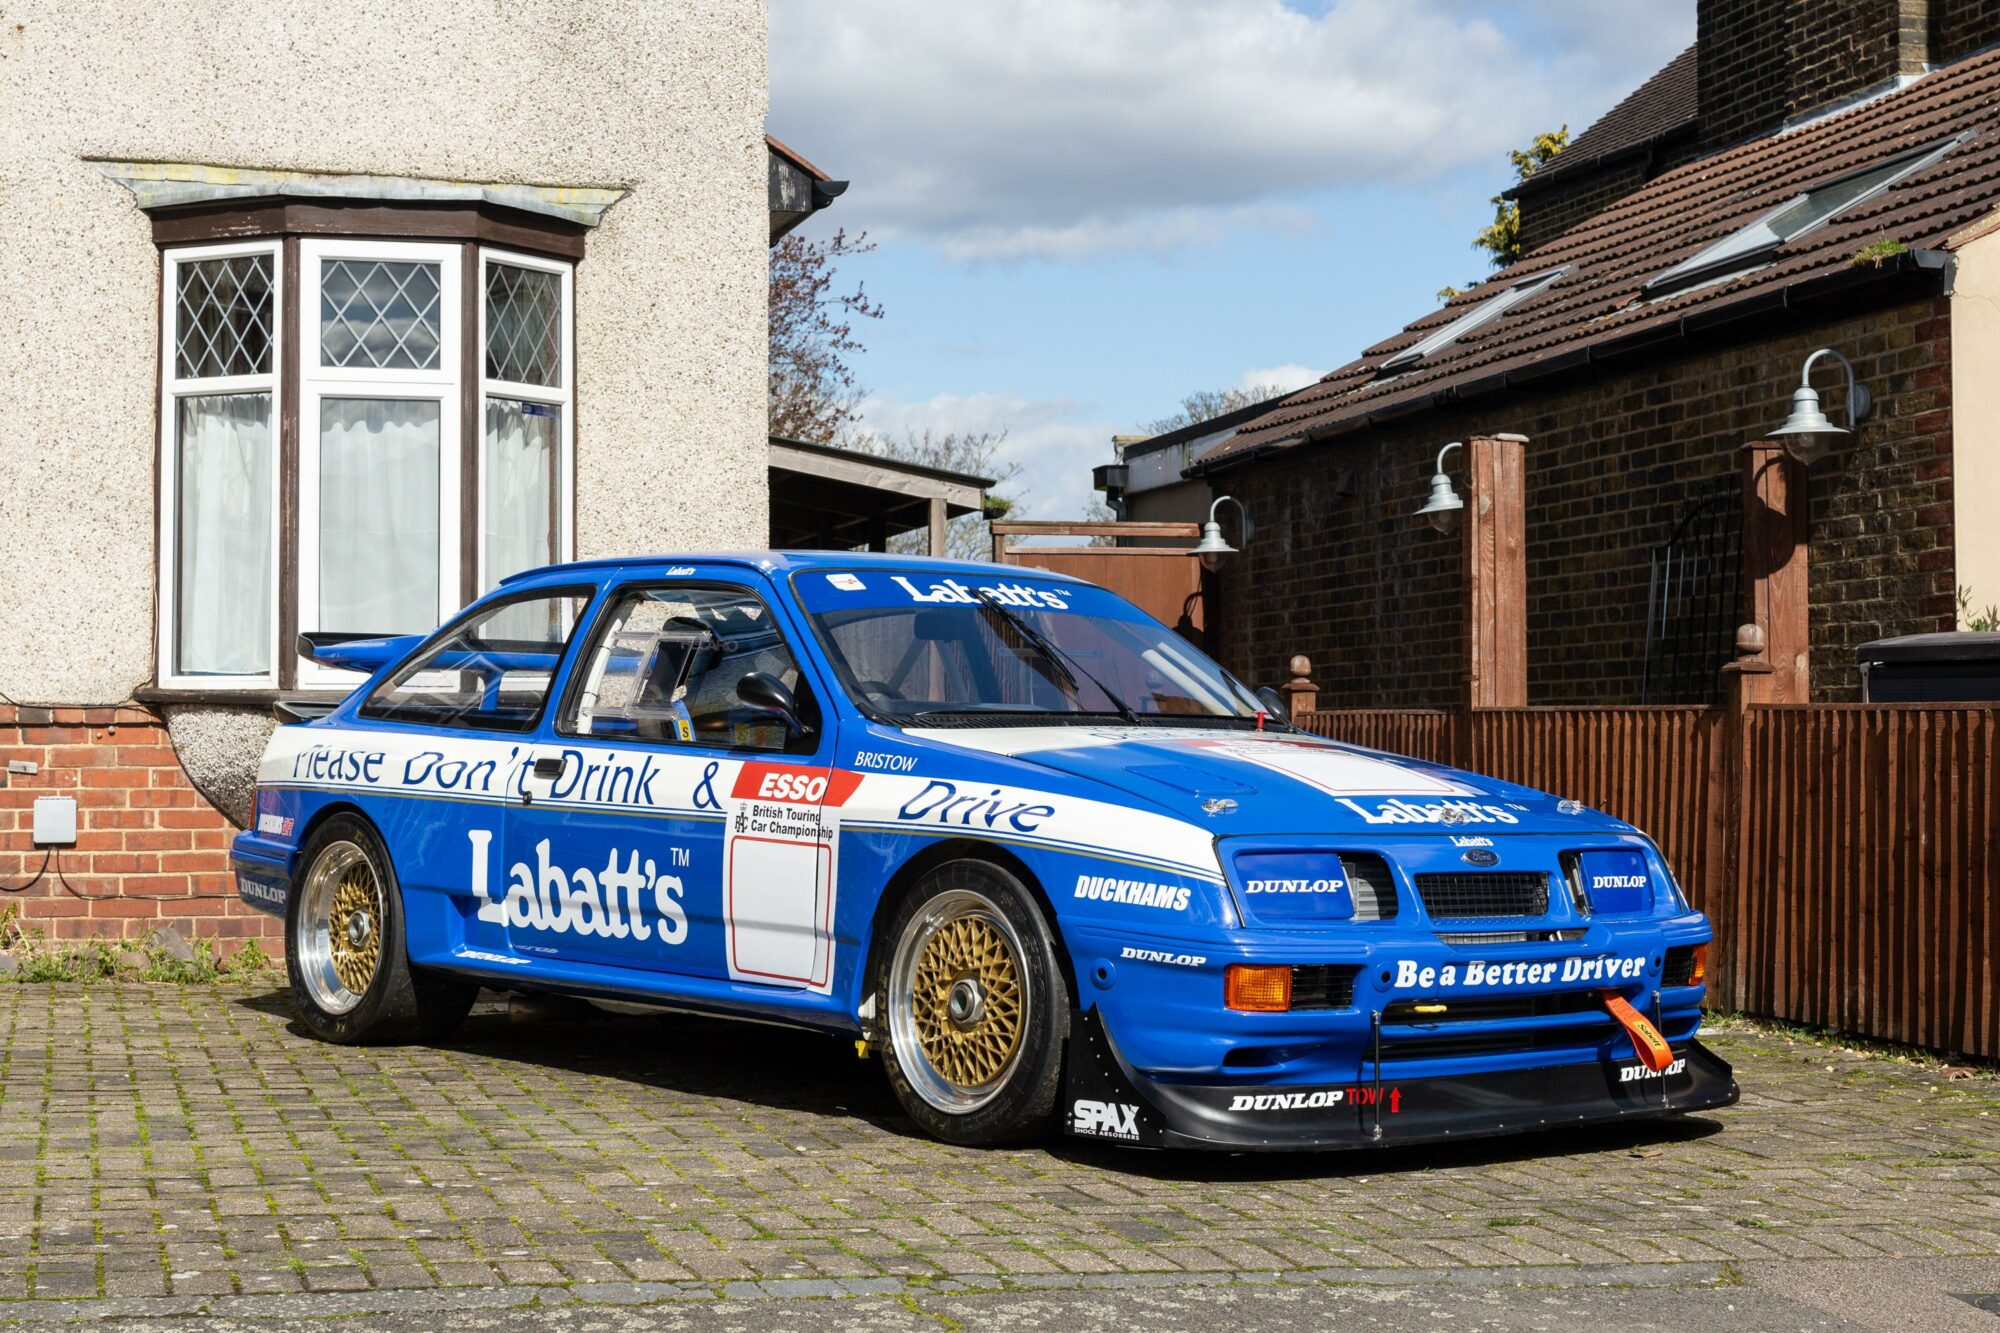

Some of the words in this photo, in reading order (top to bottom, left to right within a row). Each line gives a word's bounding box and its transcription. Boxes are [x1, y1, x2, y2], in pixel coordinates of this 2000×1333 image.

[890, 576, 1069, 610] Labatt's
[682, 726, 689, 738] S
[854, 751, 919, 772] BRISTOW
[402, 746, 536, 796] Don't
[549, 749, 661, 805] Drink
[692, 761, 723, 810] &
[897, 780, 1056, 832] Drive
[758, 772, 828, 802] ESSO
[752, 804, 783, 819] British
[786, 807, 821, 826] Touring
[1334, 798, 1520, 825] Labatt's
[751, 819, 767, 832] Car
[769, 821, 834, 841] Championship
[1449, 836, 1494, 847] Labatt's
[1472, 851, 1492, 862] Ford
[240, 878, 287, 904] DUNLOP
[468, 829, 689, 945] Labatt's
[1074, 874, 1192, 911] DUCKHAMS
[1245, 879, 1344, 893] DUNLOP
[1593, 875, 1647, 889] DUNLOP
[1120, 947, 1207, 967] DUNLOP
[1394, 960, 1436, 988] Be
[1440, 965, 1457, 986] a
[1463, 960, 1557, 986] Better
[1561, 954, 1646, 983] Driver
[1228, 1090, 1344, 1111] DUNLOP
[1345, 1087, 1384, 1105] TOW
[1074, 1099, 1140, 1135] SPAX
[1074, 1127, 1097, 1135] SHOCK
[1099, 1130, 1140, 1141] ABSORBERS
